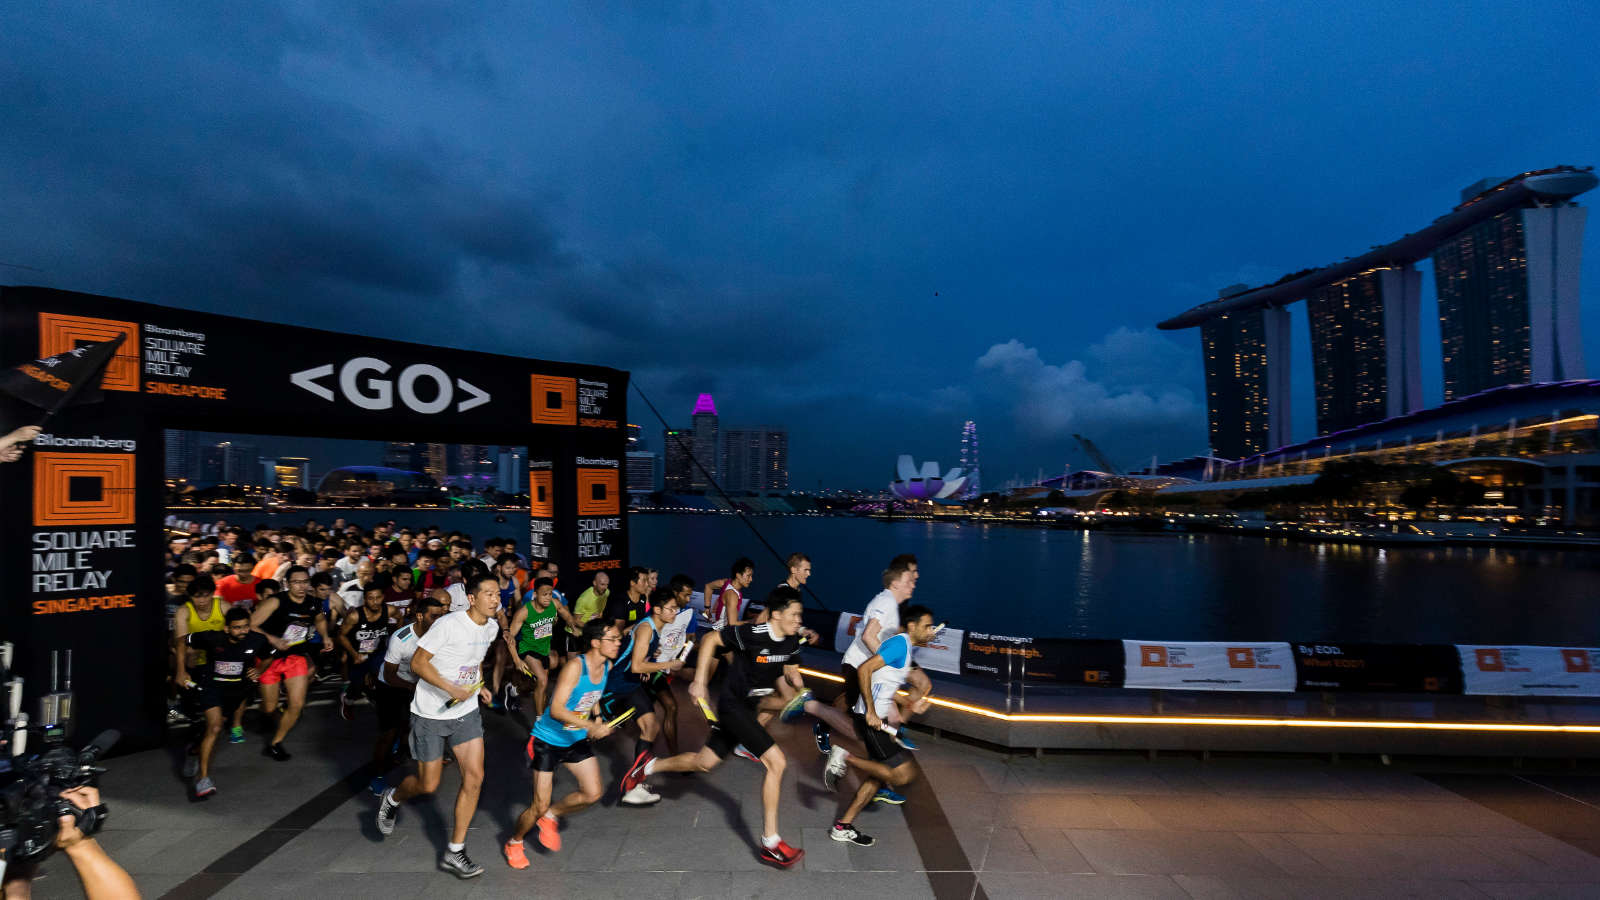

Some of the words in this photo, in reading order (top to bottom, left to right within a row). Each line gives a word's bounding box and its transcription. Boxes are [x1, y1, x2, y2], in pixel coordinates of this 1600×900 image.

[144, 324, 206, 341] Bloomberg
[145, 337, 206, 355] SQUARE
[145, 350, 181, 364] MILE
[145, 362, 192, 378] RELAY
[145, 381, 227, 400] SINGAPORE
[33, 433, 137, 451] Bloomberg
[575, 456, 620, 468] Bloomberg
[578, 518, 621, 531] SQUARE
[32, 530, 137, 551] SQUARE
[578, 532, 604, 544] MILE
[578, 544, 612, 558] RELAY
[32, 551, 93, 572] MILE
[578, 560, 622, 572] SINGAPORE
[32, 570, 113, 593] RELAY
[32, 594, 137, 615] SINGAPORE
[969, 631, 989, 640] Had
[990, 634, 1033, 645] enough?
[968, 642, 997, 654] Tough
[1299, 645, 1313, 656] By
